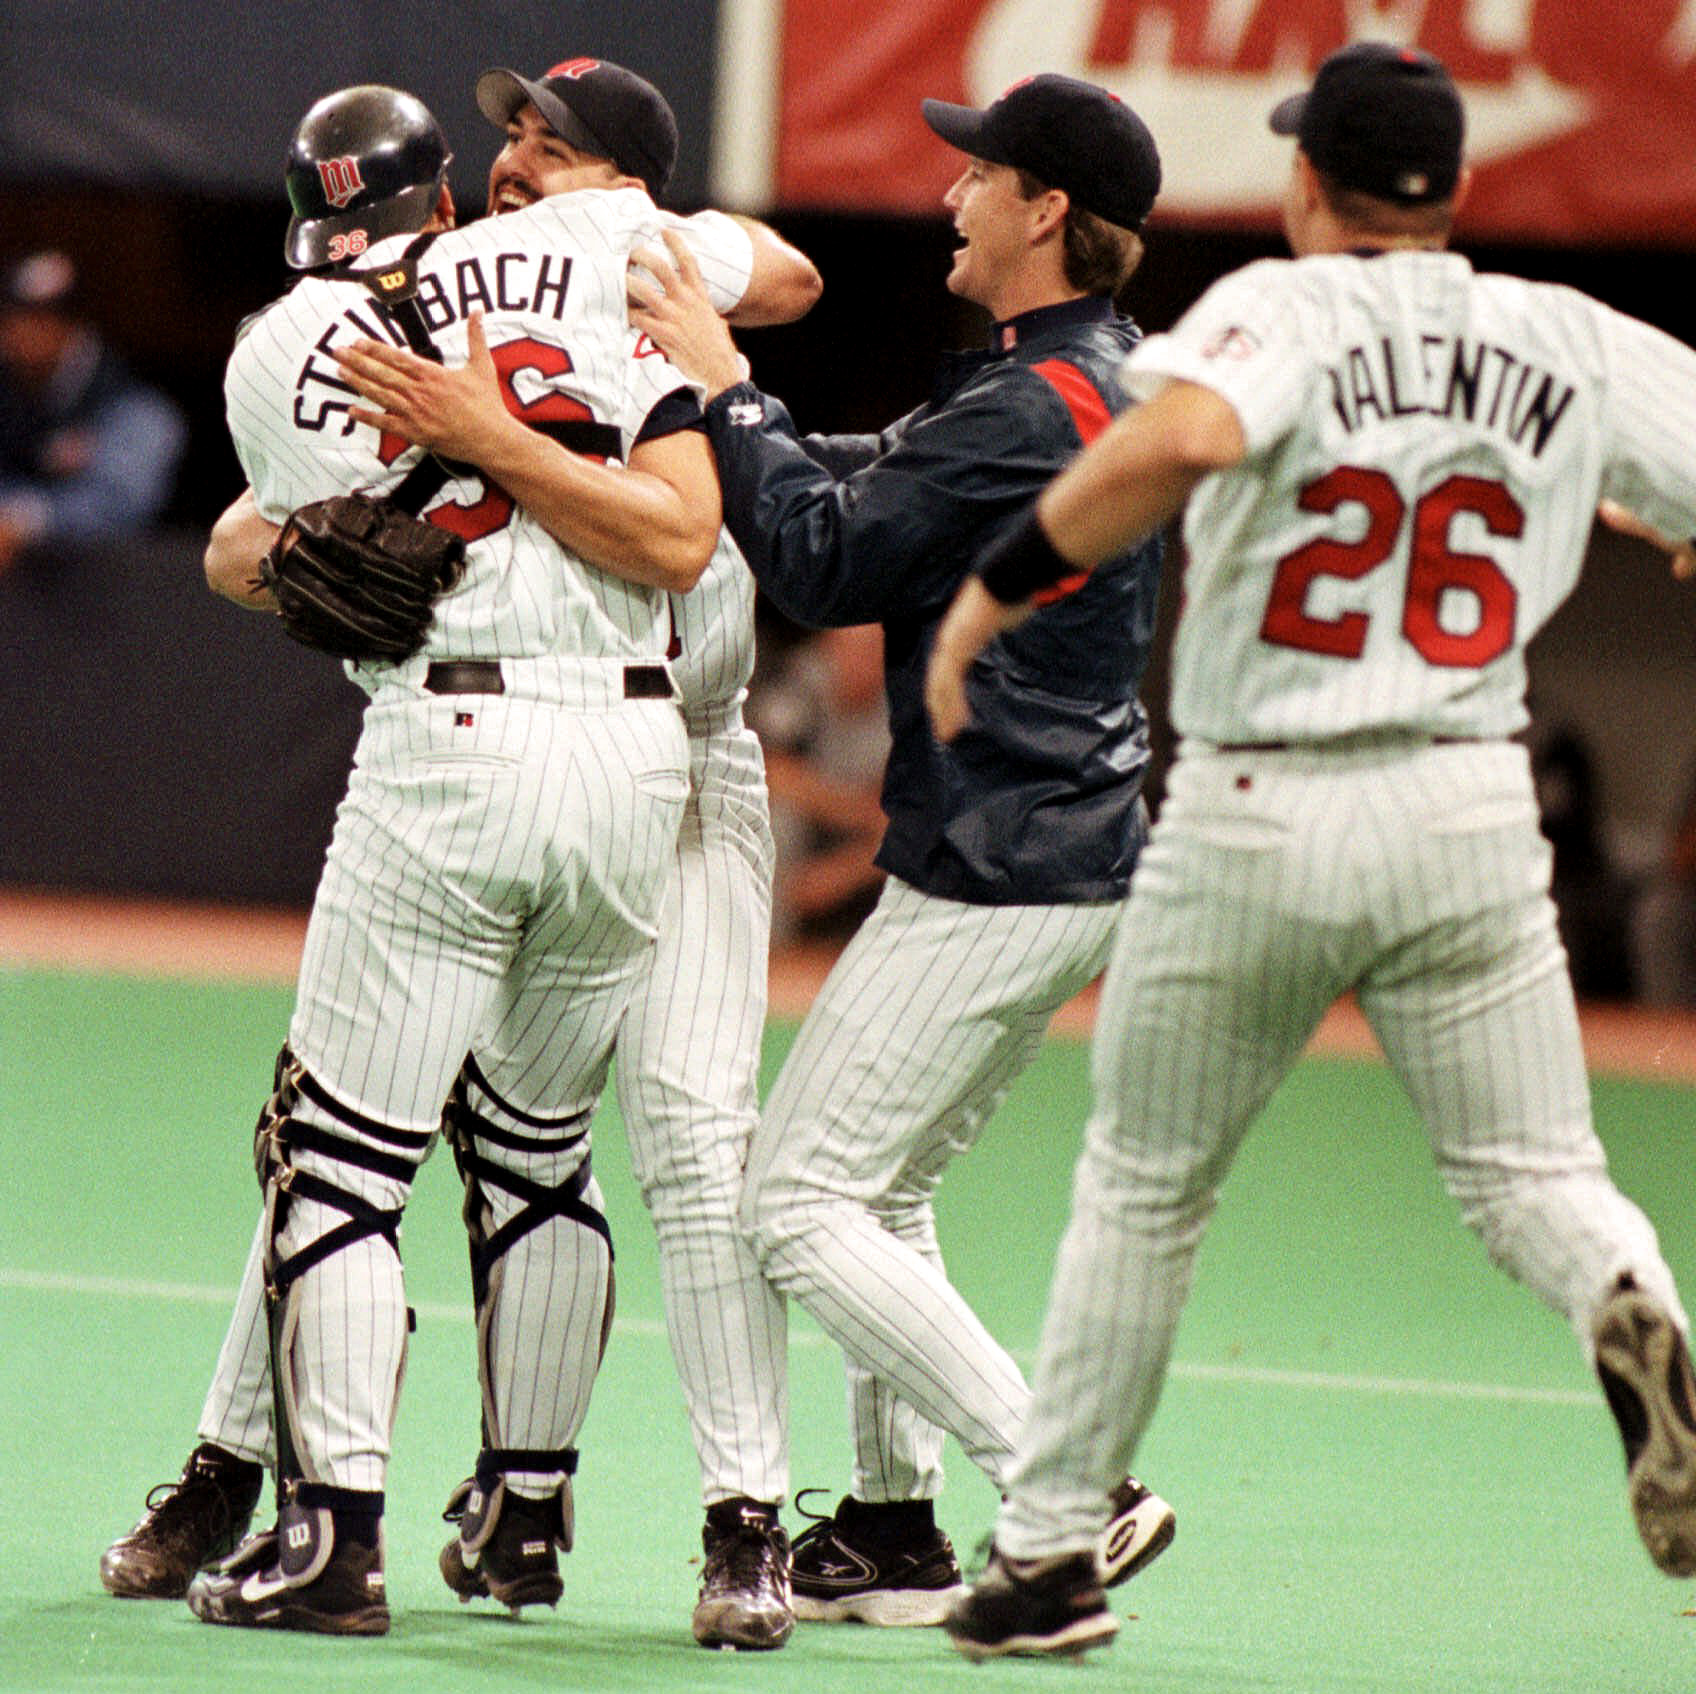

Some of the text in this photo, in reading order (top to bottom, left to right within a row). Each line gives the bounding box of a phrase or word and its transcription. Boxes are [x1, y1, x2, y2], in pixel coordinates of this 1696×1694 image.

[328, 230, 367, 260] 36
[1328, 335, 1575, 460] VALENTIN
[1259, 464, 1526, 669] 26
